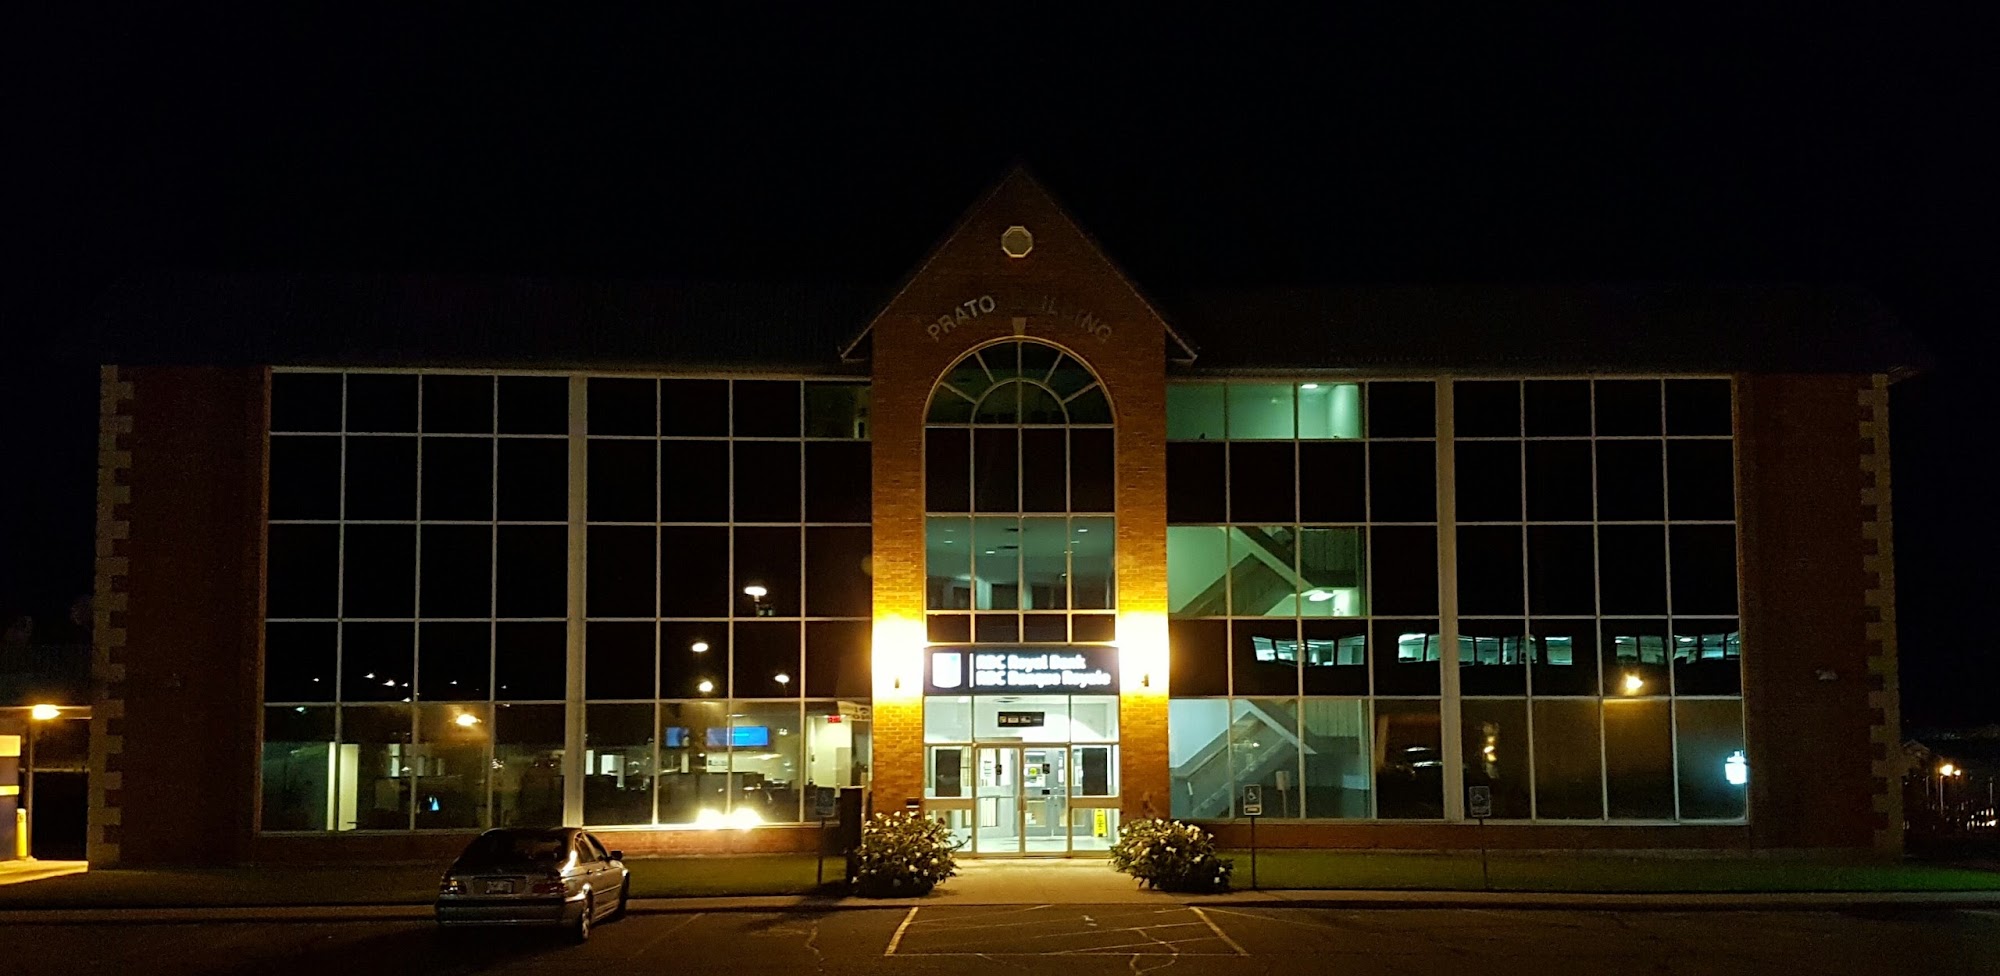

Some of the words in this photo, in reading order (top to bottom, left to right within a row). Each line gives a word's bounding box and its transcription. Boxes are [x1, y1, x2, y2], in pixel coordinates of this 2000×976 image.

[926, 294, 997, 343] PRATO
[1007, 654, 1049, 673] Royal
[1050, 654, 1087, 670] Bank
[1007, 670, 1061, 689] Banque
[1062, 670, 1111, 689] Royale
